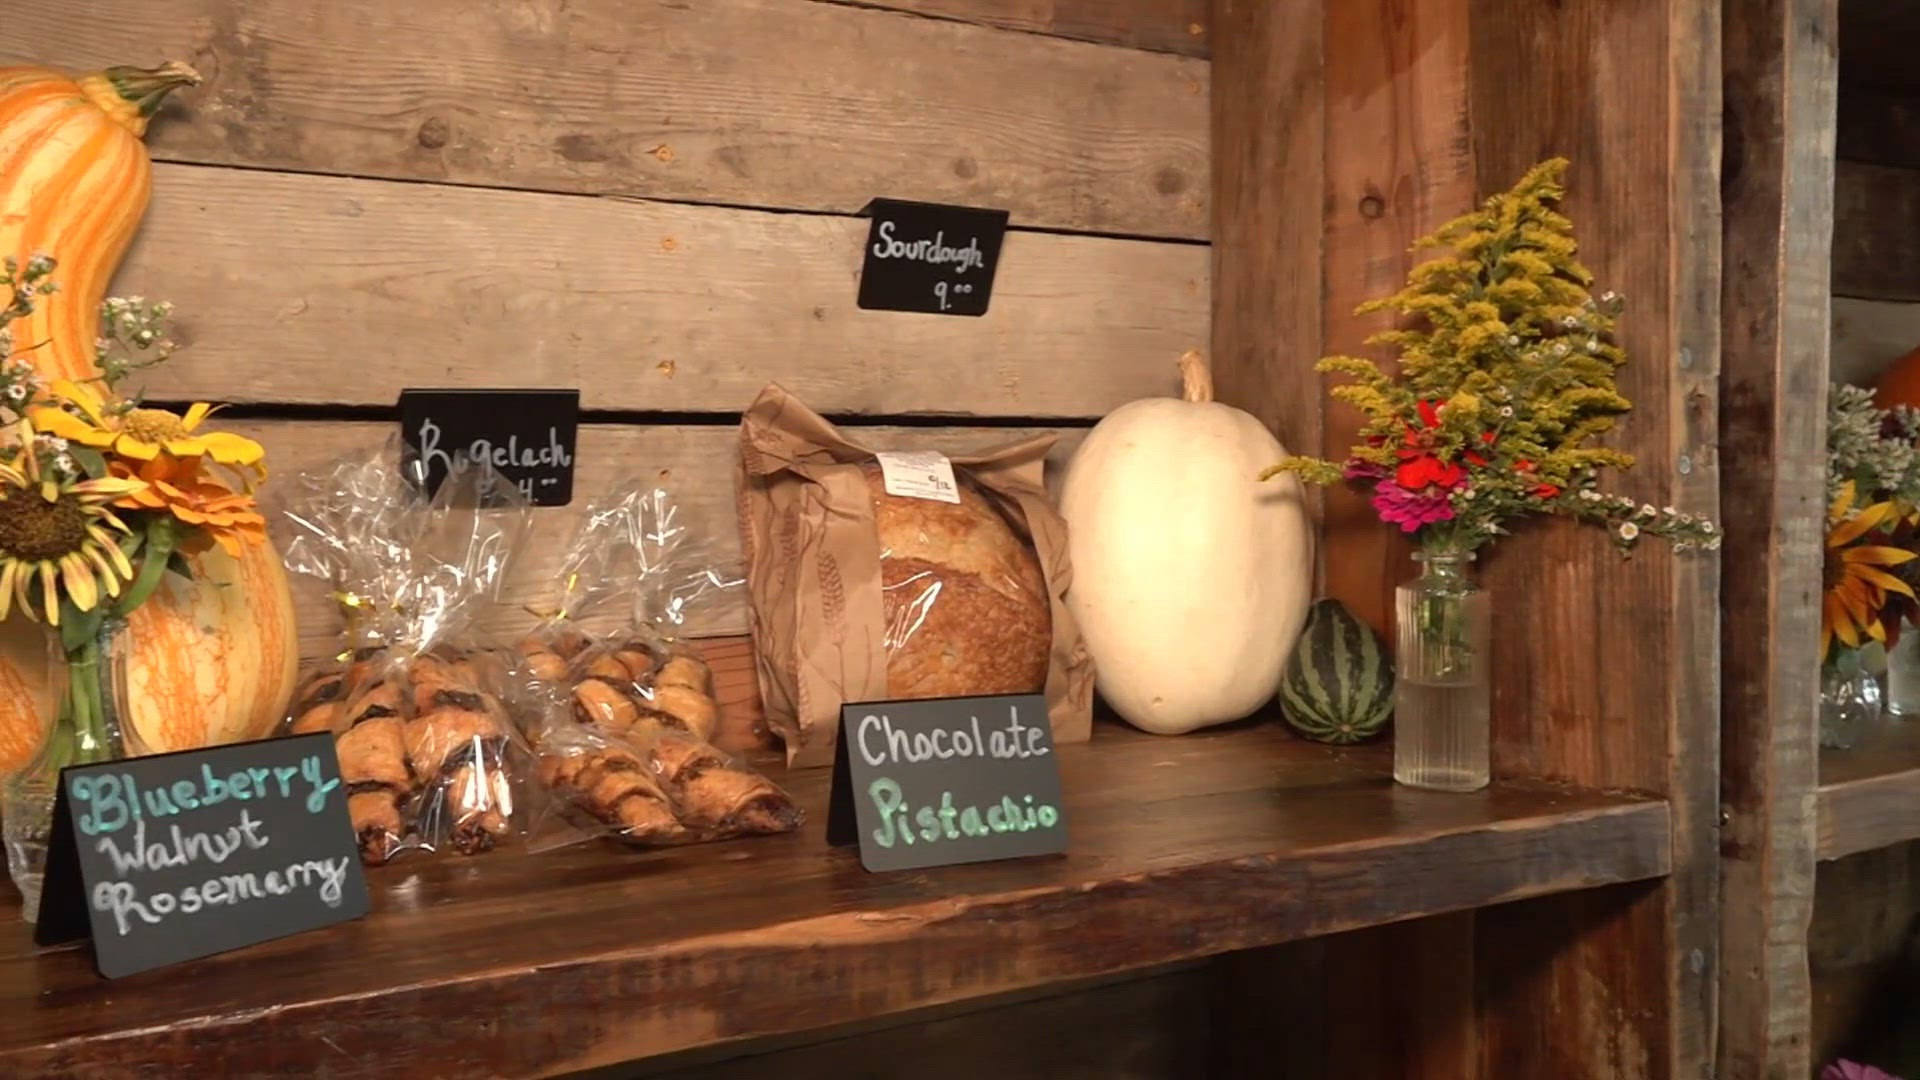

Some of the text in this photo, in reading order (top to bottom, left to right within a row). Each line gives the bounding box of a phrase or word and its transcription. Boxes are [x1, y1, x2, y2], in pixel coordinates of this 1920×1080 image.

[873, 221, 984, 273] Sourdough
[858, 705, 1049, 766] Chocolate
[72, 756, 340, 835] Blueberry
[868, 777, 1058, 848] Pistachio
[96, 809, 269, 876] Walnut
